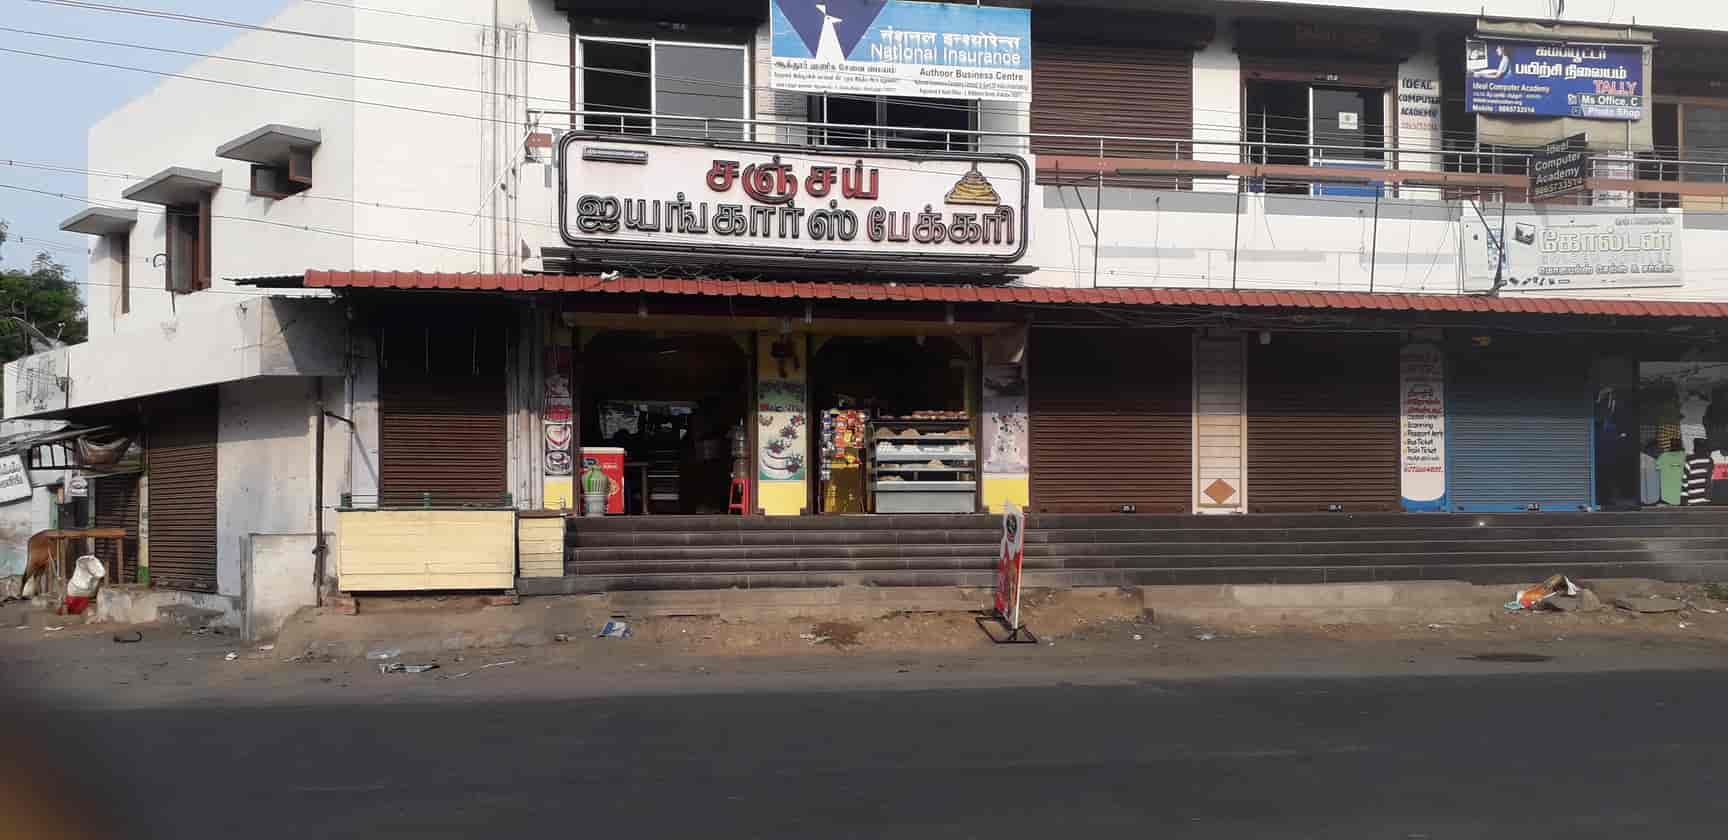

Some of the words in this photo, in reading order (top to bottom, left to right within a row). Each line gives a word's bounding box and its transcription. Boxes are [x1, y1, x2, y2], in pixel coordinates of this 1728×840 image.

[871, 43, 937, 63] National
[944, 46, 1020, 65] Insurance
[955, 69, 993, 80] Business
[995, 71, 1024, 81] Centre
[1515, 61, 1562, 78] பயிற்சி
[1565, 64, 1627, 80] நிலையம்
[1402, 79, 1433, 90] IDEAL
[1593, 80, 1637, 95] TALLY
[1536, 153, 1581, 170] Computer
[706, 154, 879, 203] சஞ்சய்
[1536, 166, 1580, 185] Academy
[867, 204, 1015, 245] பேக்கரி
